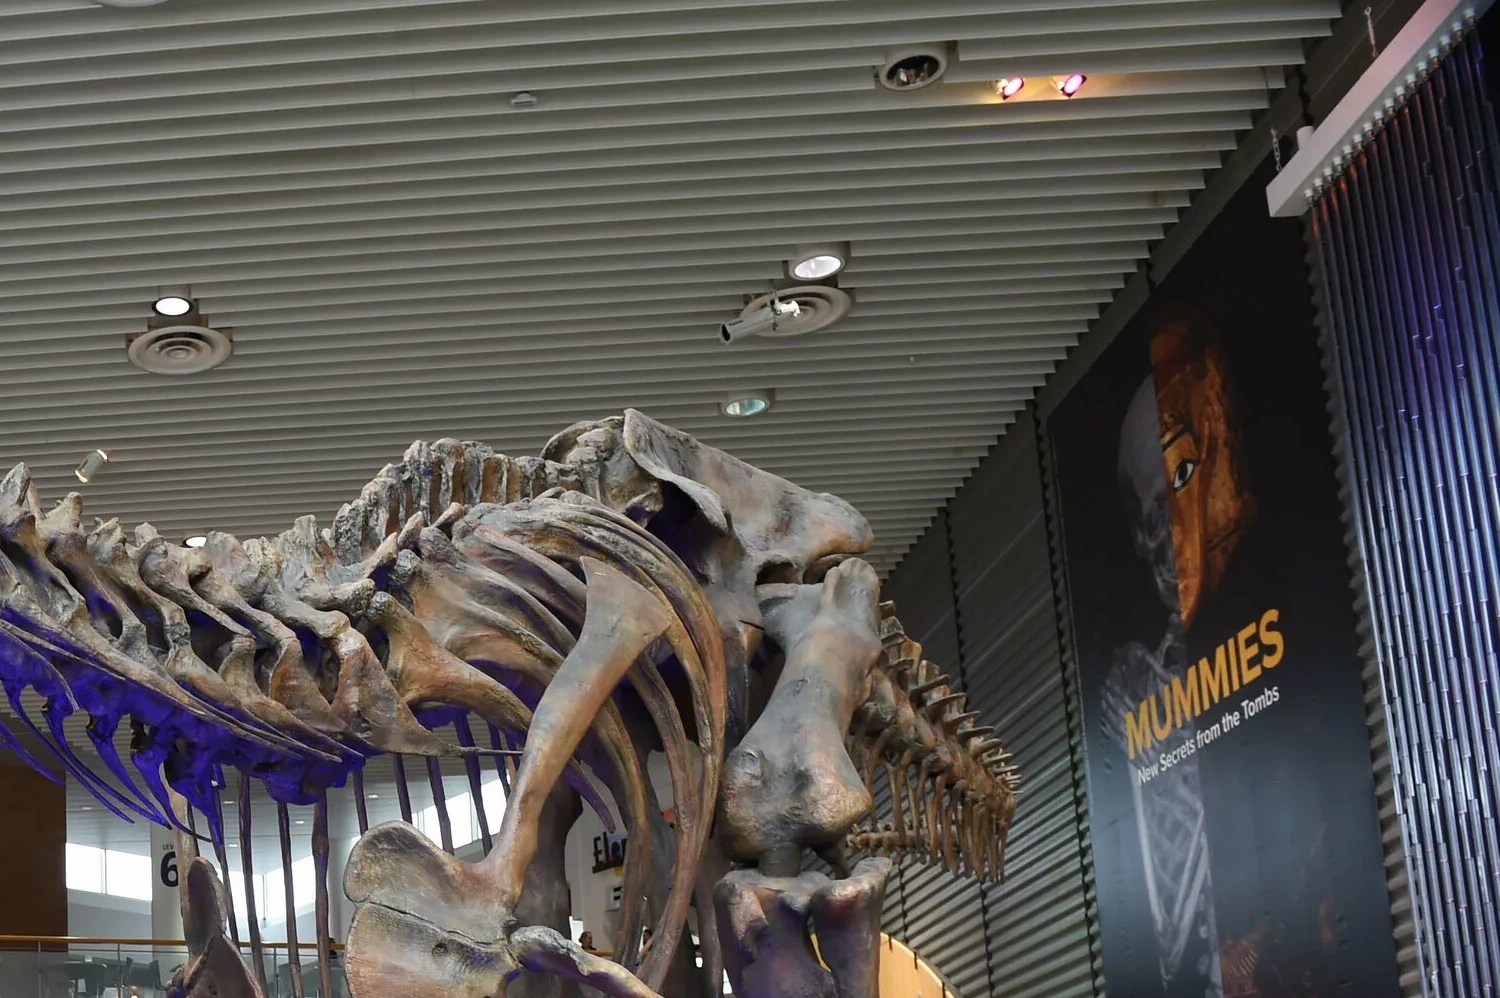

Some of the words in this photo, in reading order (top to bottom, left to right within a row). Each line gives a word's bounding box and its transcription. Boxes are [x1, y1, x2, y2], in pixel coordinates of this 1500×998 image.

[1124, 608, 1285, 761] MUMMIES
[1137, 762, 1159, 786] New
[1159, 738, 1196, 772] Secrets
[1196, 722, 1221, 749] from
[1221, 710, 1241, 733] the
[1241, 686, 1280, 720] Tombs
[161, 851, 179, 887] 6
